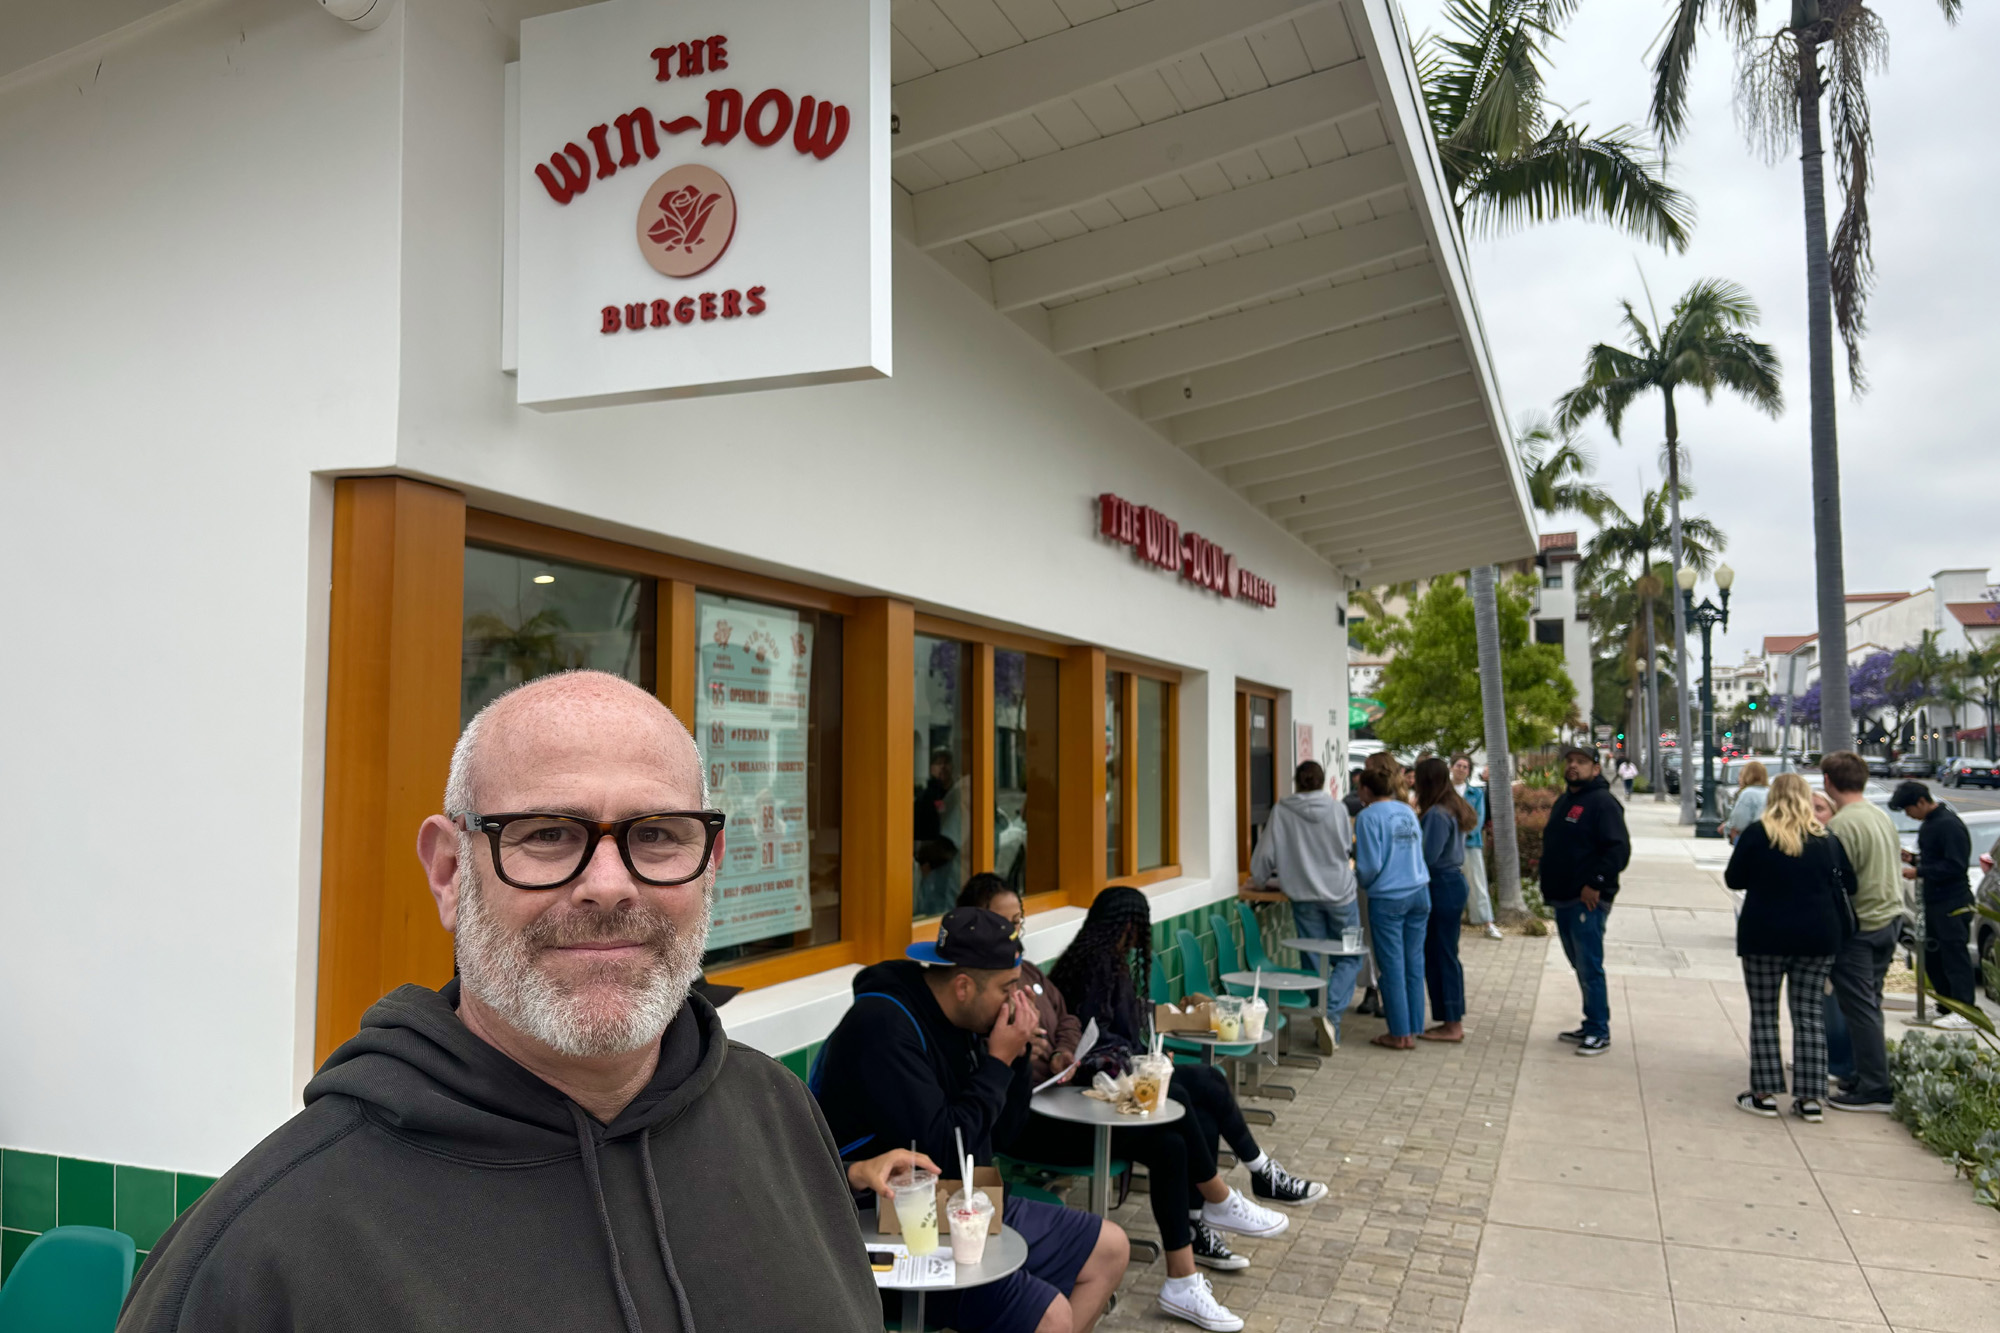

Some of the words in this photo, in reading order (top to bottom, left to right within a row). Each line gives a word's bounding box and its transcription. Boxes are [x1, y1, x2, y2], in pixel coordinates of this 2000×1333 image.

[650, 34, 729, 82] THE
[600, 285, 767, 334] BURGERS
[1099, 493, 1141, 546] THE
